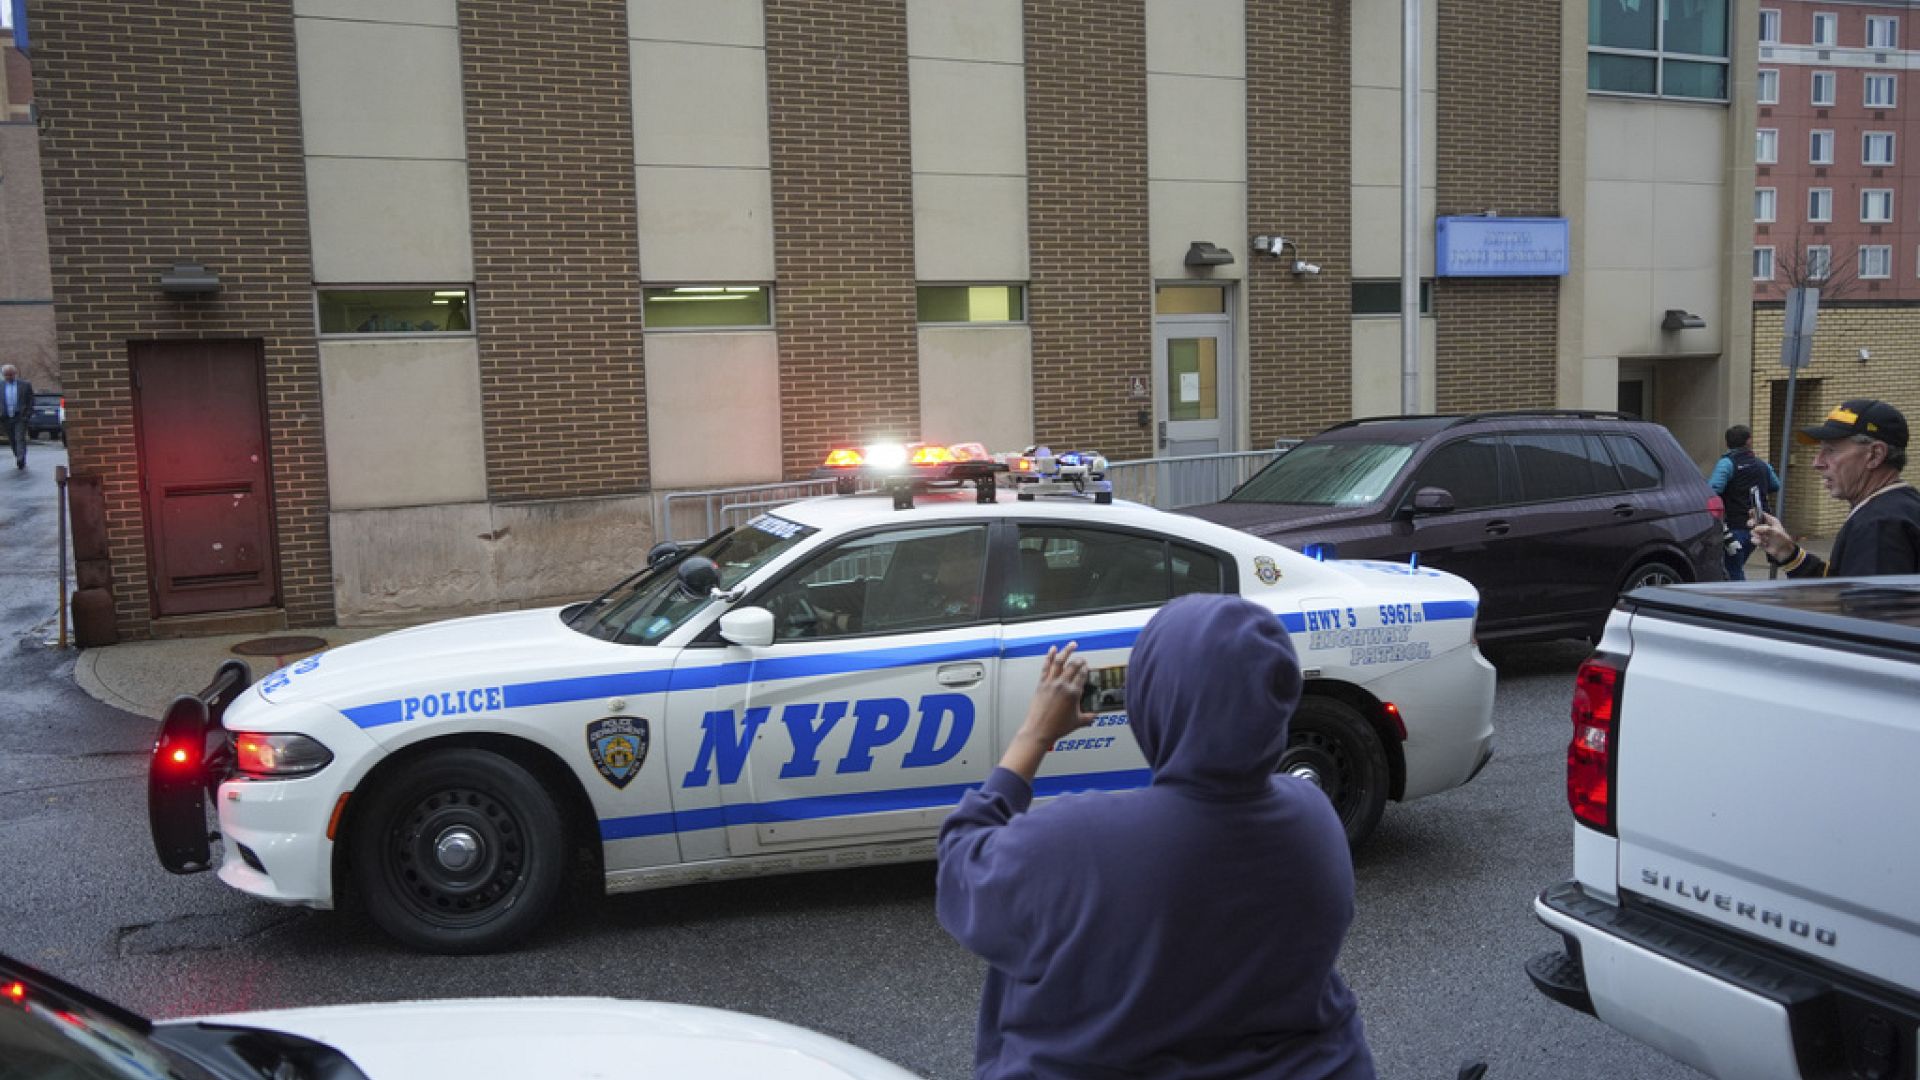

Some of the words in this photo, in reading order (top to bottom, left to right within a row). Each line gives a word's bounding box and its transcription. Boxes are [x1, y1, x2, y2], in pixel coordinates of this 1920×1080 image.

[1306, 608, 1341, 632] HWY
[1346, 607, 1357, 628] 5
[1379, 603, 1413, 626] 5967
[1308, 625, 1412, 651] HIGHWAY
[1350, 642, 1432, 666] PATROL
[404, 686, 501, 721] POLICE
[682, 693, 976, 788] NYPD
[1048, 736, 1116, 752] ESPECT
[1641, 868, 1837, 947] SILVERADO
